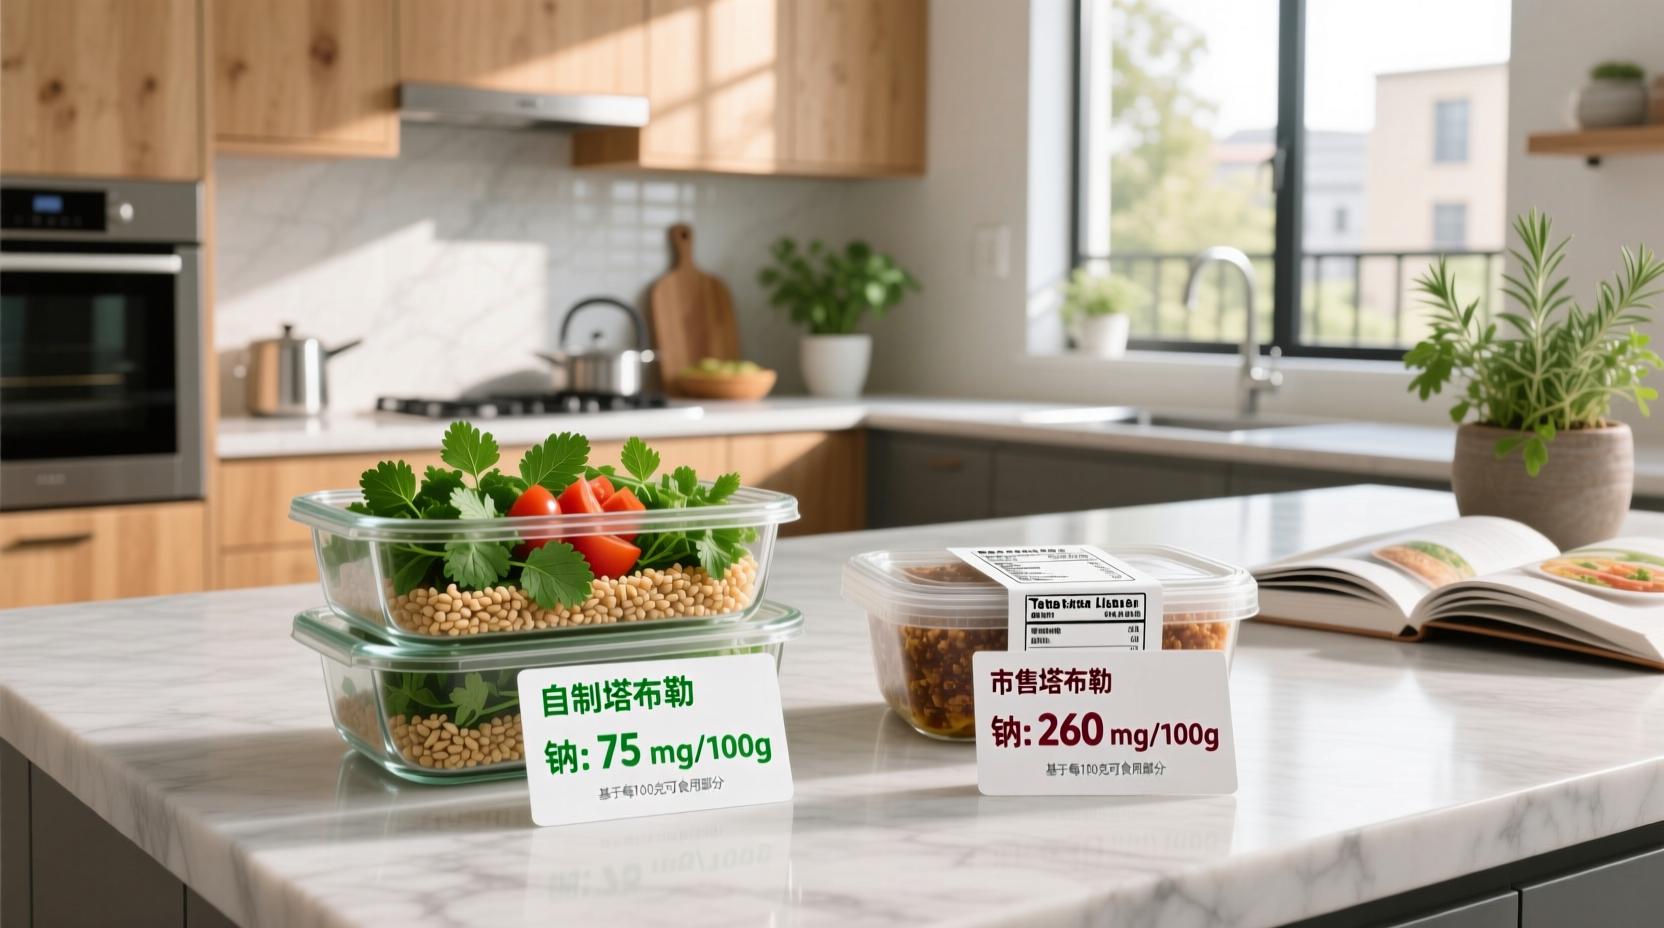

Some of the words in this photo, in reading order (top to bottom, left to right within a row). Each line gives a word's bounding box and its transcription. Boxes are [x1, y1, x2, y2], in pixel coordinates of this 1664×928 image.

[541, 675, 694, 718] 自制塔布勒
[990, 666, 1112, 696] 市售塔布勒
[596, 731, 642, 770] 75
[649, 732, 772, 771] mg/100g
[1037, 711, 1104, 747] 260
[1110, 722, 1220, 753] mg/100g
